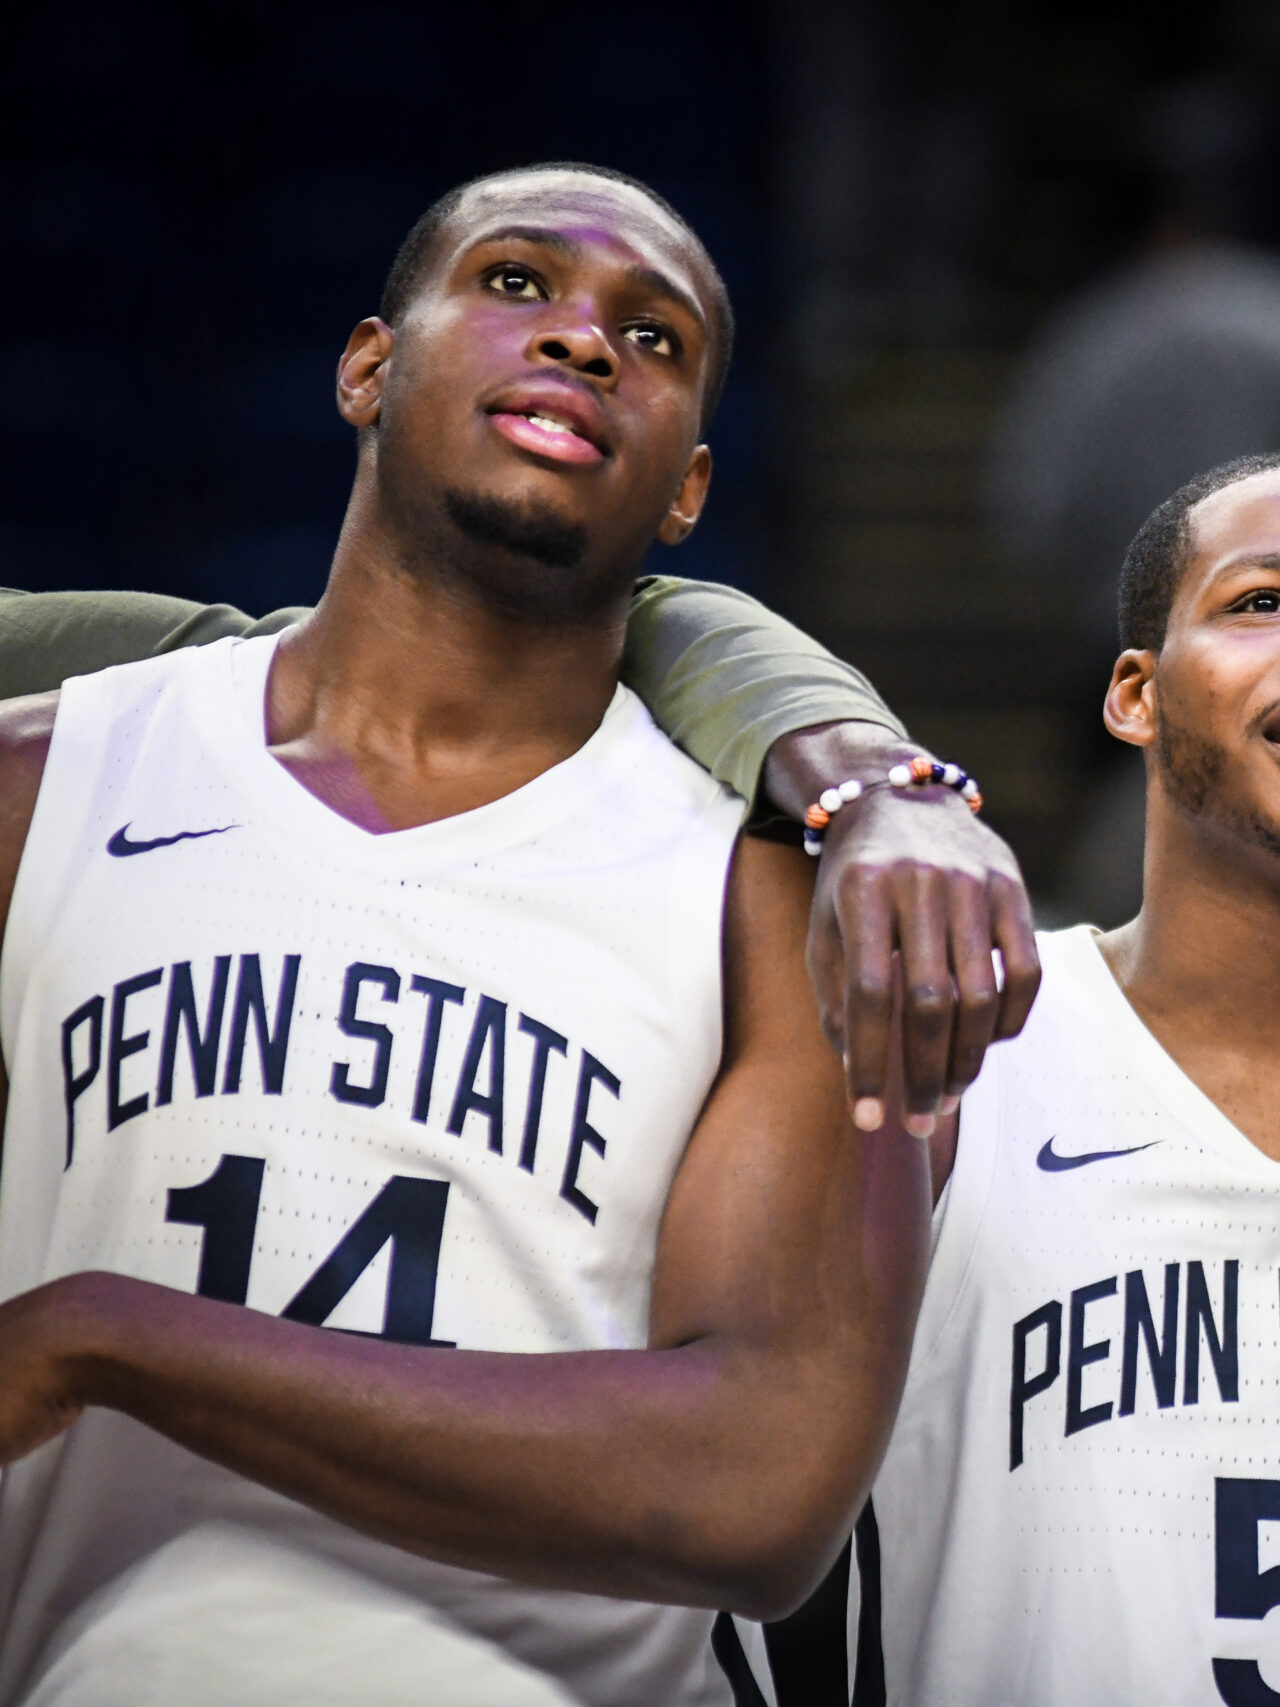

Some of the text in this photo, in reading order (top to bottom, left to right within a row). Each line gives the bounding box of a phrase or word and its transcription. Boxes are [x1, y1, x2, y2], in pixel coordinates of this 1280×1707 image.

[61, 953, 621, 1227] PENN STATE
[165, 1154, 457, 1349] 14
[1009, 1259, 1239, 1472] PENN
